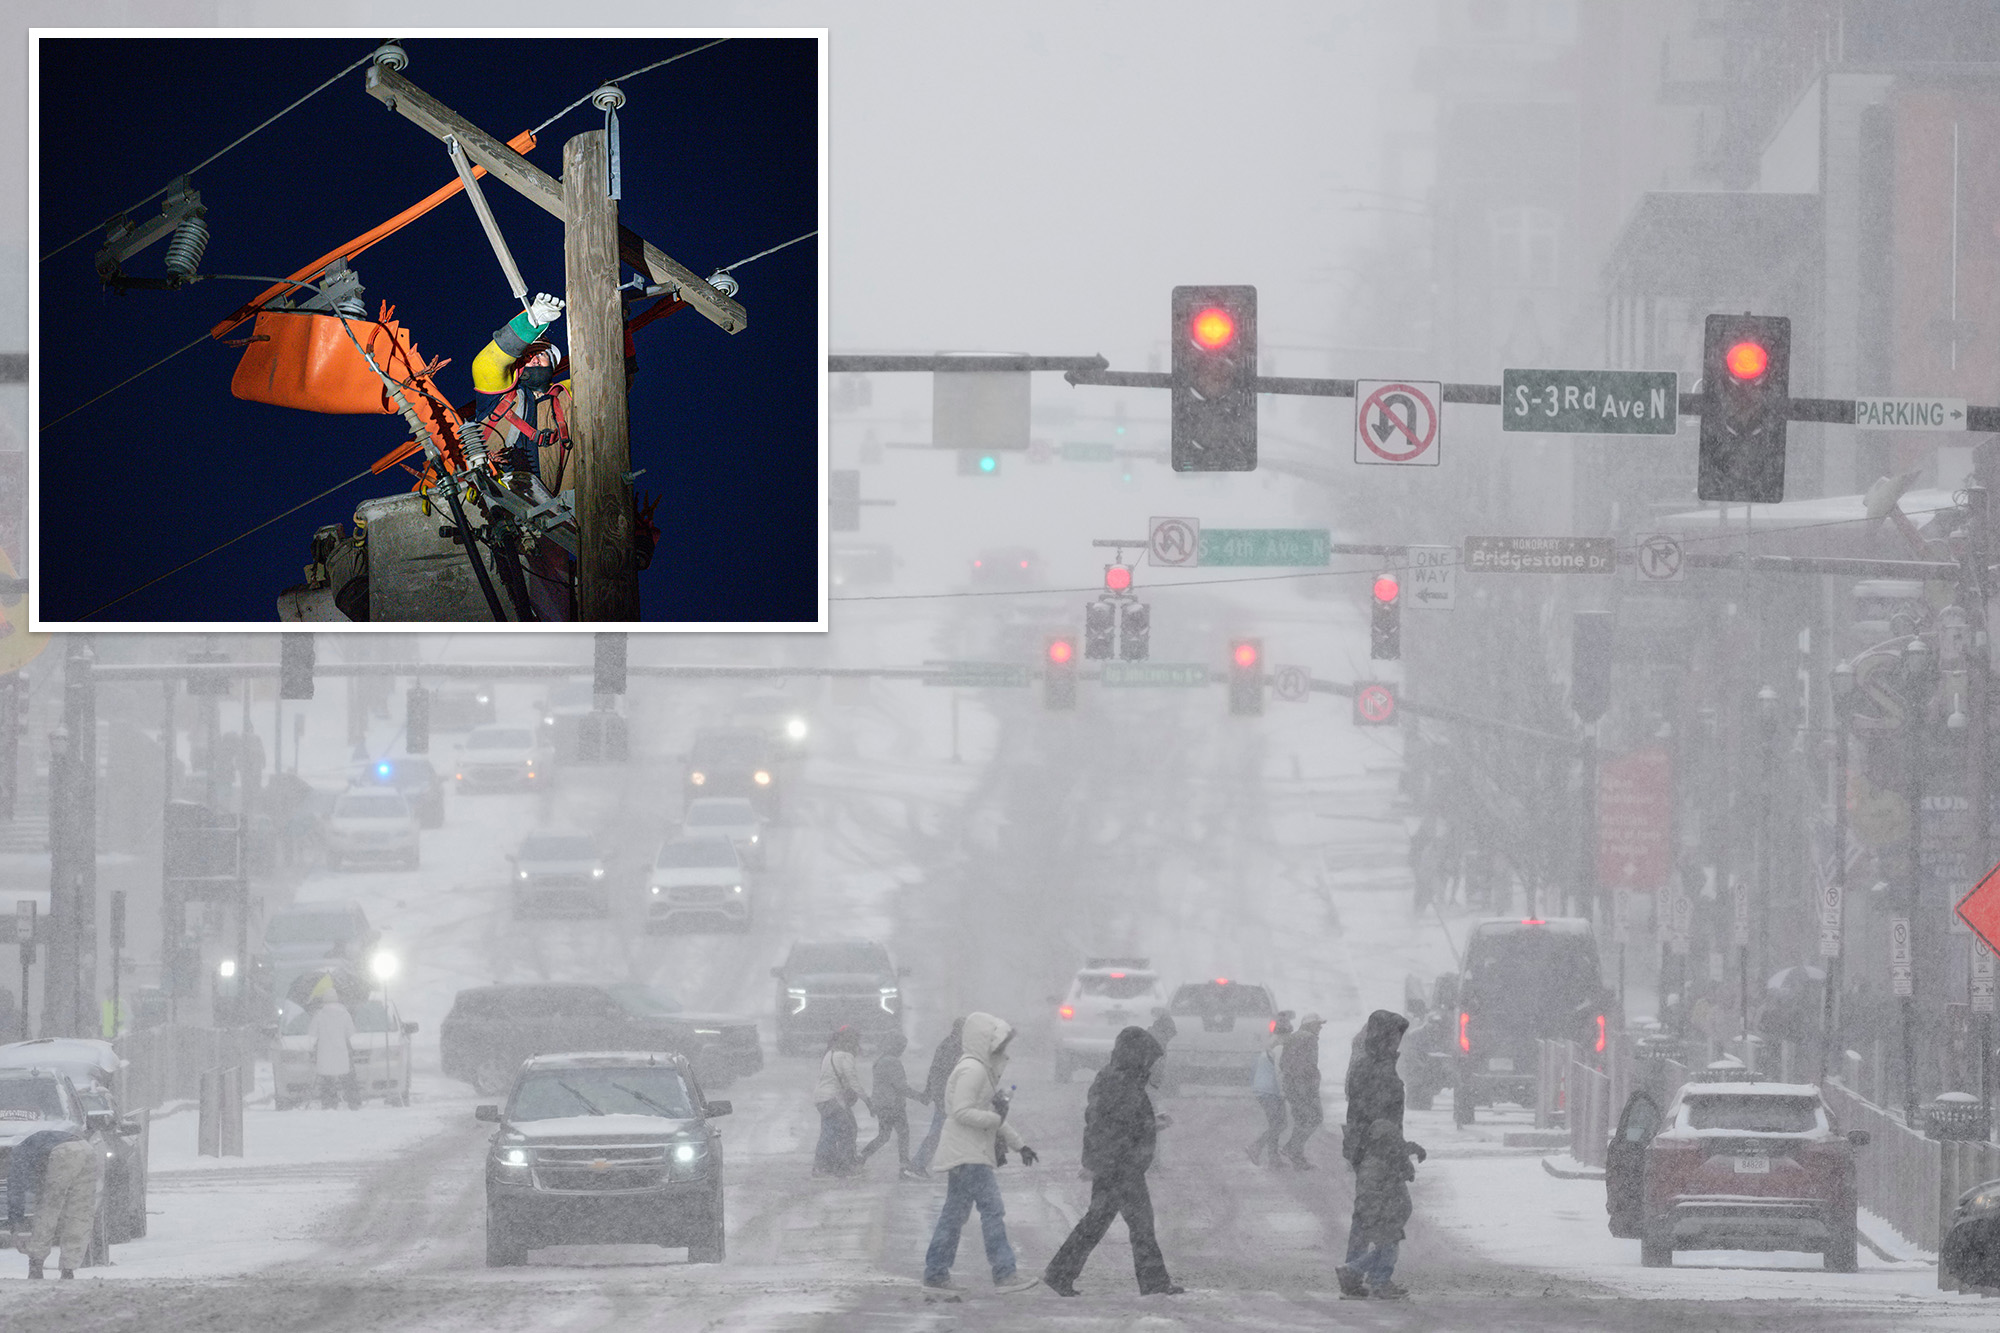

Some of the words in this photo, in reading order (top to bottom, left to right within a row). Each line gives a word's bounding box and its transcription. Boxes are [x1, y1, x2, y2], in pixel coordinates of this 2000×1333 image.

[1601, 393, 1645, 419] Ave
[1650, 388, 1666, 420] N
[1856, 400, 1945, 426] PARKING
[1512, 539, 1561, 550] HONORARY
[1416, 551, 1450, 568] ONE
[1472, 550, 1585, 570] Bridgestone
[1588, 555, 1608, 569] Dr
[1415, 568, 1450, 584] WAY
